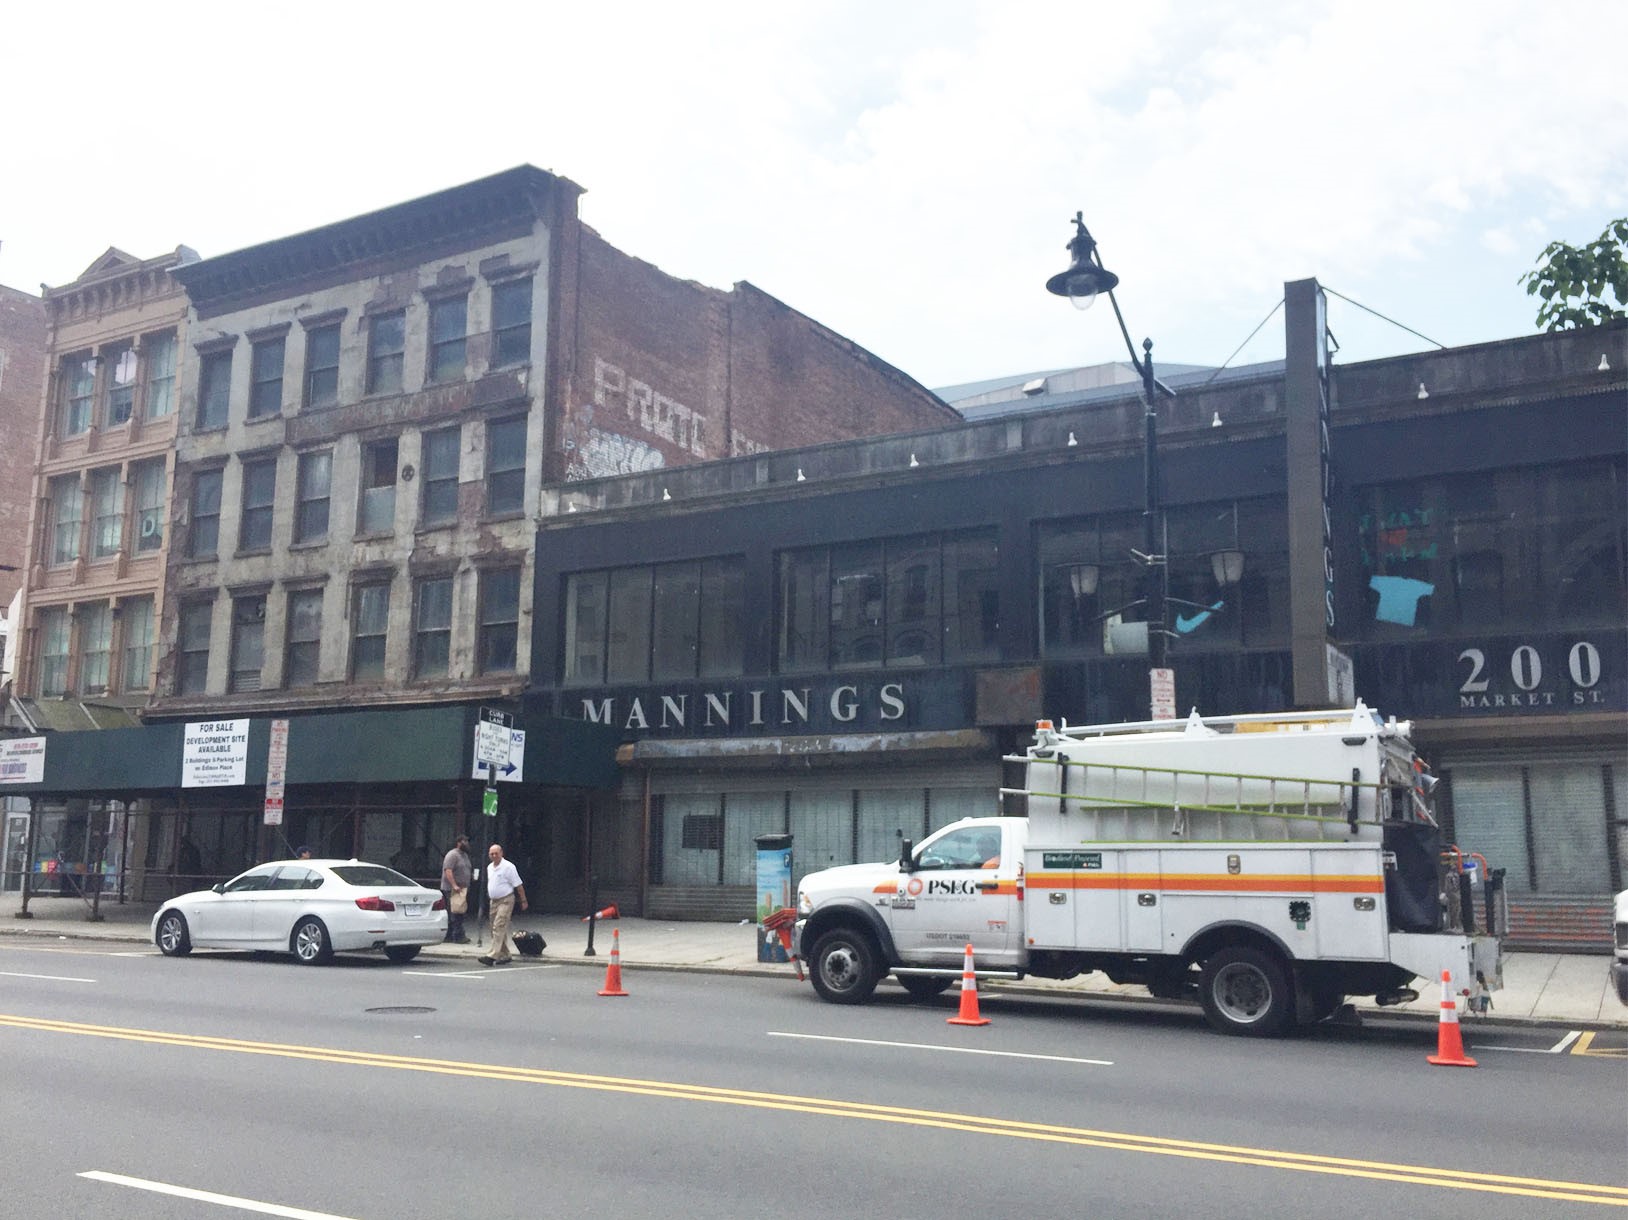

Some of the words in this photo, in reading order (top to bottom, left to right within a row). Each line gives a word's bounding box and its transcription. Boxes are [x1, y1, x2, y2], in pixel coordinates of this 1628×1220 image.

[1457, 641, 1601, 694] 200
[1460, 693, 1556, 709] MARKET
[1573, 690, 1606, 705] ST.
[582, 683, 905, 730] MANNINGS
[489, 710, 505, 719] CURB
[489, 717, 504, 725] LANE
[199, 724, 214, 733] FOR
[215, 723, 234, 732] SALE
[186, 736, 231, 745] DEVELOPMENT
[231, 735, 246, 743] SITE
[198, 745, 231, 753] AVAILABLE
